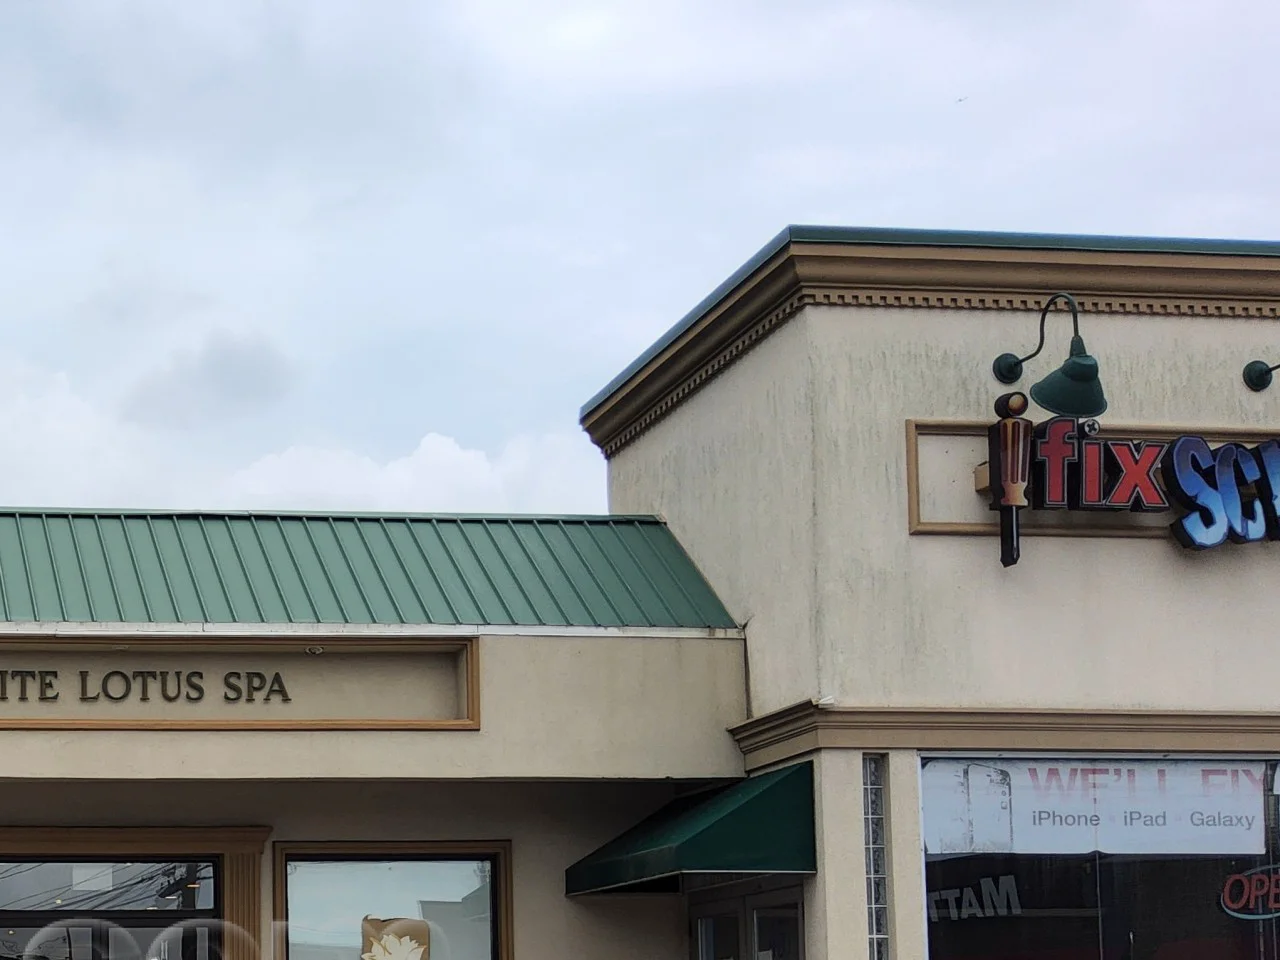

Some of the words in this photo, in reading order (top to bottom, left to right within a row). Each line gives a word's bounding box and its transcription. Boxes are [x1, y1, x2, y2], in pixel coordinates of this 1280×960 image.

[78, 670, 205, 702] LOTUS
[223, 671, 292, 702] SPA
[1032, 811, 1101, 827] iPhone
[1123, 811, 1167, 827] iPad
[1190, 811, 1256, 831] Galaxy
